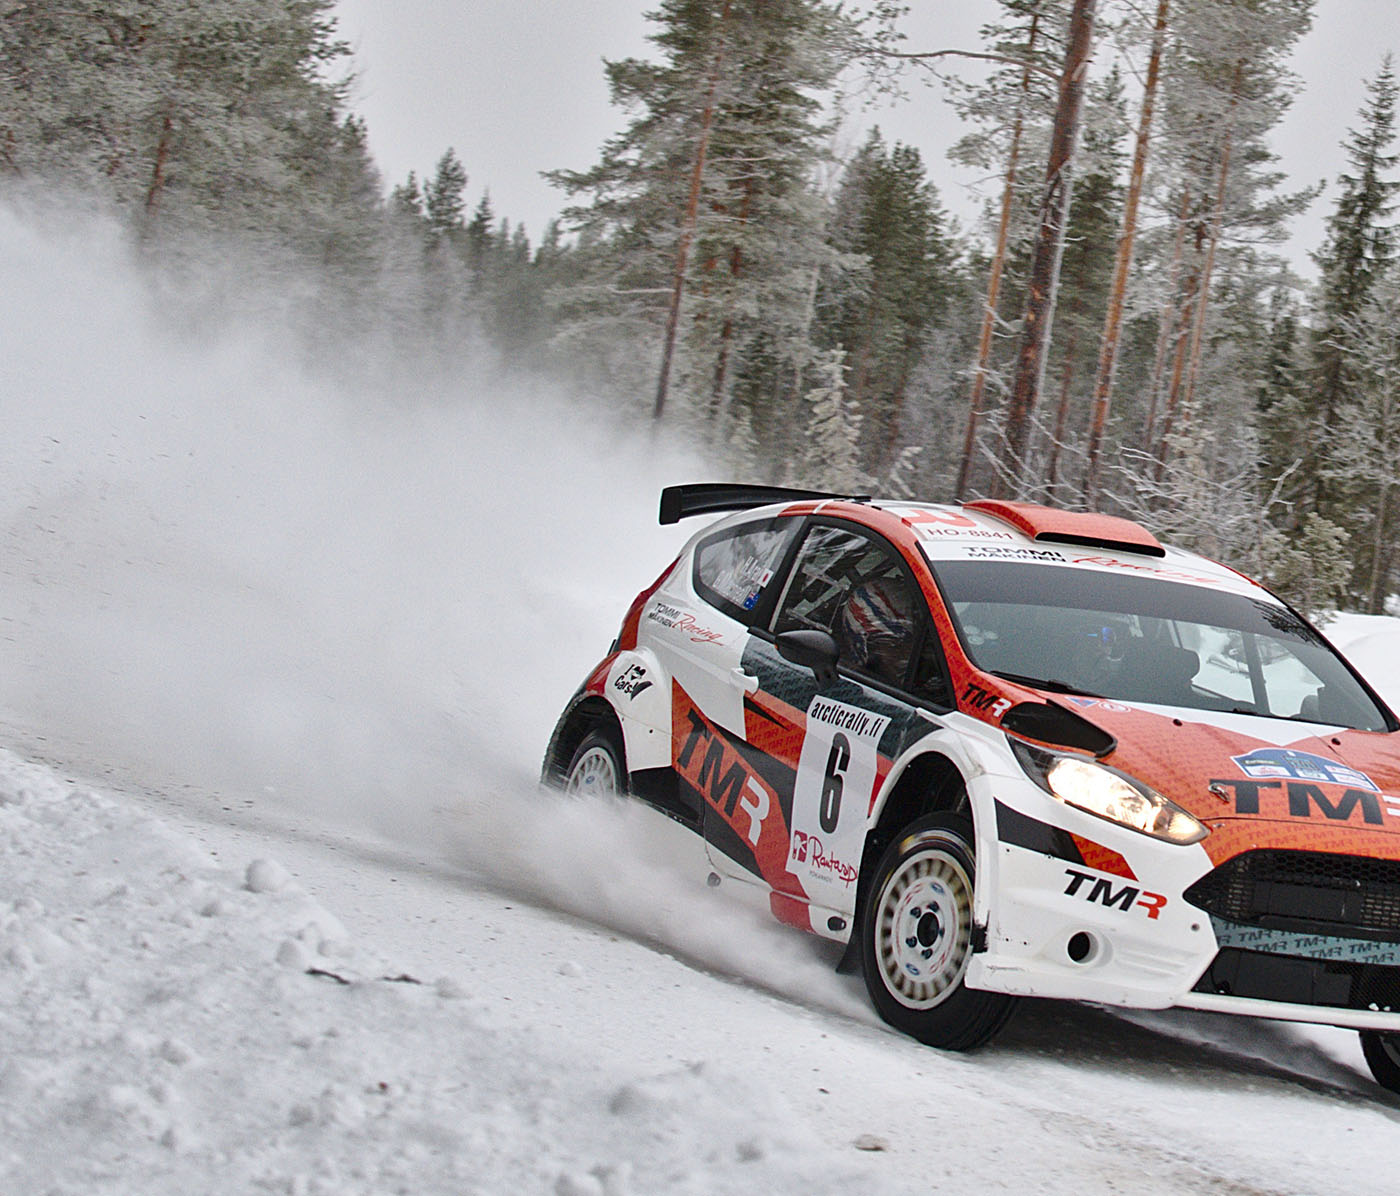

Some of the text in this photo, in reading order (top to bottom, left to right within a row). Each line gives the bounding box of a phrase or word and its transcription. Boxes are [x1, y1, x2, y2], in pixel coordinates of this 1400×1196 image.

[962, 546, 1062, 558] TOMMI
[672, 613, 724, 646] Racing
[961, 683, 1012, 717] TMR
[811, 702, 885, 738] arcticrally.fi
[677, 708, 770, 847] TMR
[819, 732, 851, 834] 6
[1063, 868, 1168, 920] TMR
